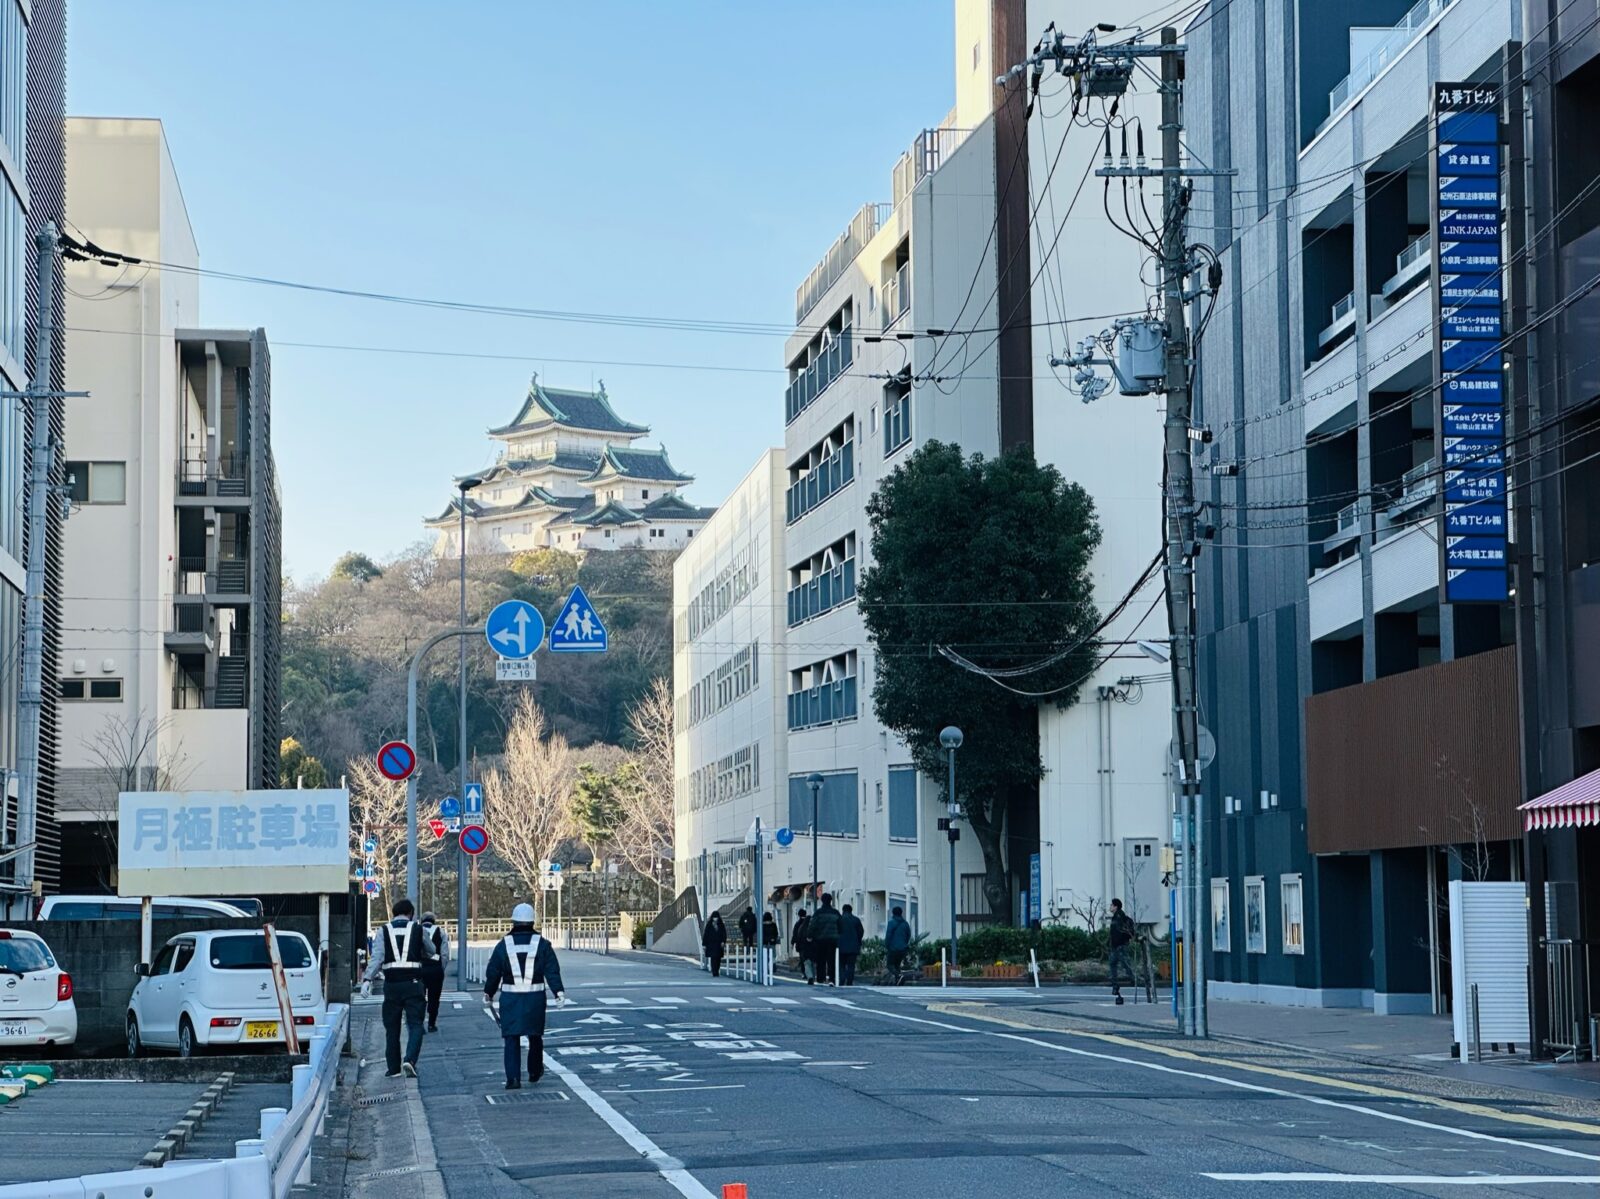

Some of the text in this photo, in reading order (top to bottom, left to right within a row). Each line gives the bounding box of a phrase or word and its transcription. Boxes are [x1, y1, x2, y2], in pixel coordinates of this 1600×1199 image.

[1440, 90, 1496, 104] 九番丁ビル
[1448, 154, 1491, 165] 貸会議室
[1443, 226, 1497, 235] LINK JAPAN
[133, 803, 341, 853] 月極駐車場
